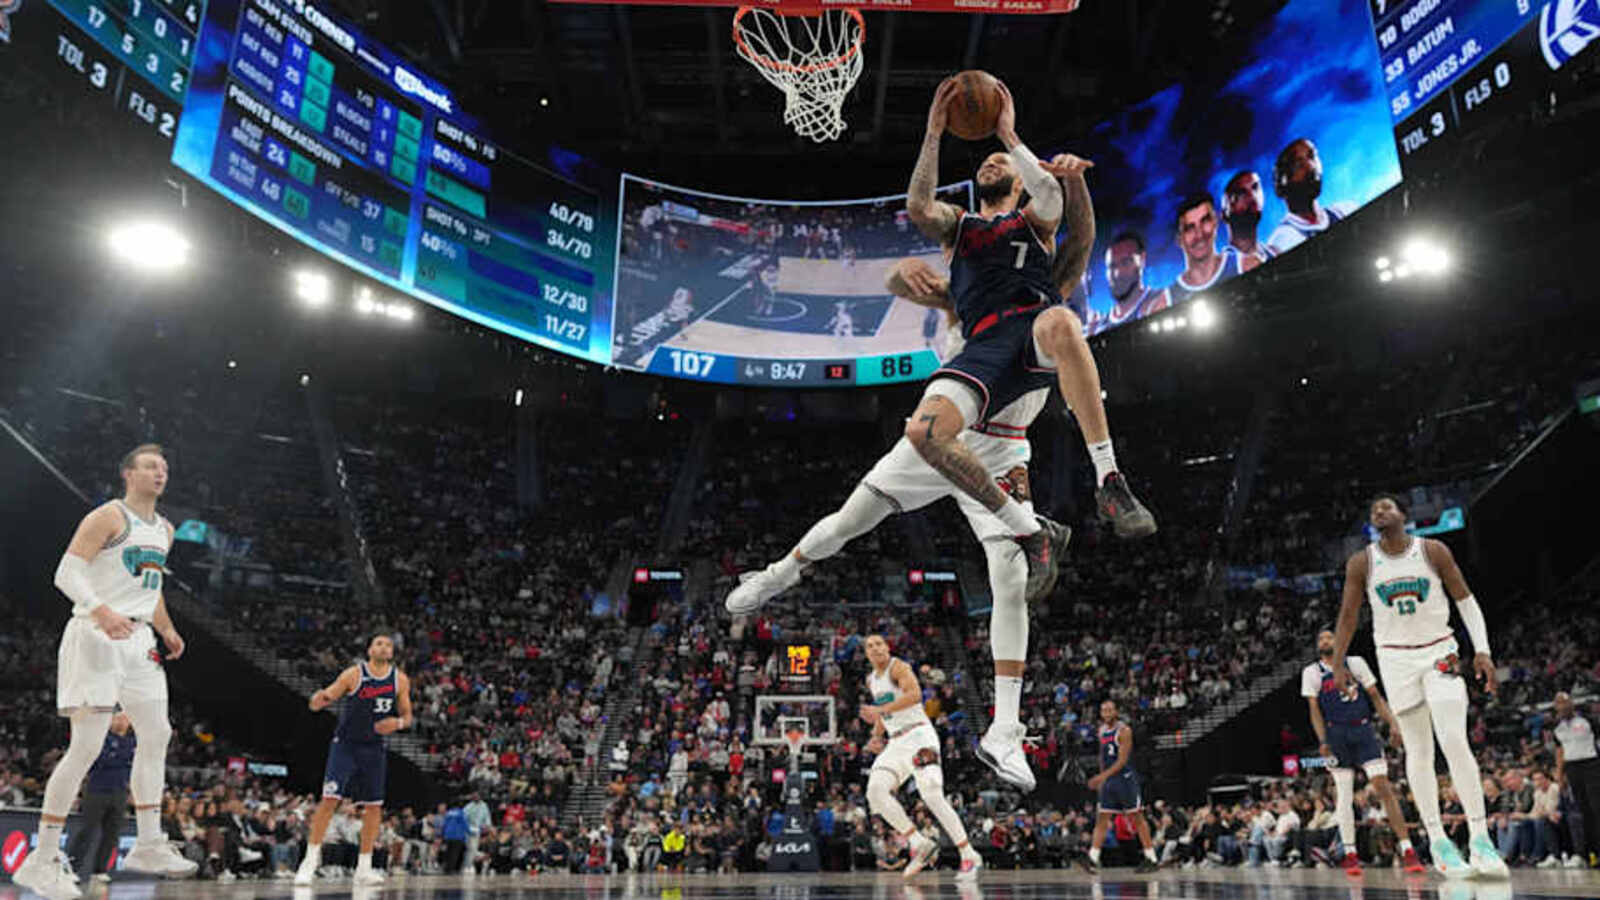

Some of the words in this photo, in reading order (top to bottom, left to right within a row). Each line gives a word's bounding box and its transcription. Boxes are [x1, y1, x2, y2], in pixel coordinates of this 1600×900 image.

[154, 17, 167, 38] 0
[181, 38, 189, 56] 1
[304, 5, 355, 53] CORNER
[1379, 25, 1397, 49] 10
[57, 35, 86, 73] TOL
[90, 62, 108, 88] 3
[121, 33, 135, 54] 5
[146, 53, 159, 74] 3
[170, 71, 184, 93] 2
[1385, 57, 1405, 83] 33
[1406, 17, 1454, 65] BATUM
[1391, 90, 1412, 116] 55
[1415, 54, 1459, 99] JONES
[1459, 38, 1482, 65] JR.
[1464, 78, 1492, 111] FLS
[1494, 62, 1511, 88] 0
[128, 91, 157, 123] FLS
[158, 112, 175, 137] 2
[229, 83, 272, 122] POINTS
[271, 113, 343, 169] BREAKDOWN
[437, 119, 463, 143] SHOT
[1402, 127, 1428, 155] TOL
[1430, 112, 1446, 137] 3
[266, 142, 286, 167] 24
[363, 200, 382, 219] 37
[426, 206, 452, 229] SHOT
[421, 231, 456, 260] 40%
[547, 229, 592, 259] 34/70
[1009, 241, 1029, 270] 7
[544, 284, 588, 312] 12/30
[546, 315, 588, 341] 11/27
[669, 351, 716, 377] 107
[770, 362, 806, 381] 9:47
[881, 356, 913, 376] 86
[142, 571, 160, 590] 10
[1397, 600, 1416, 615] 13
[791, 657, 809, 675] 12
[373, 698, 394, 713] 33
